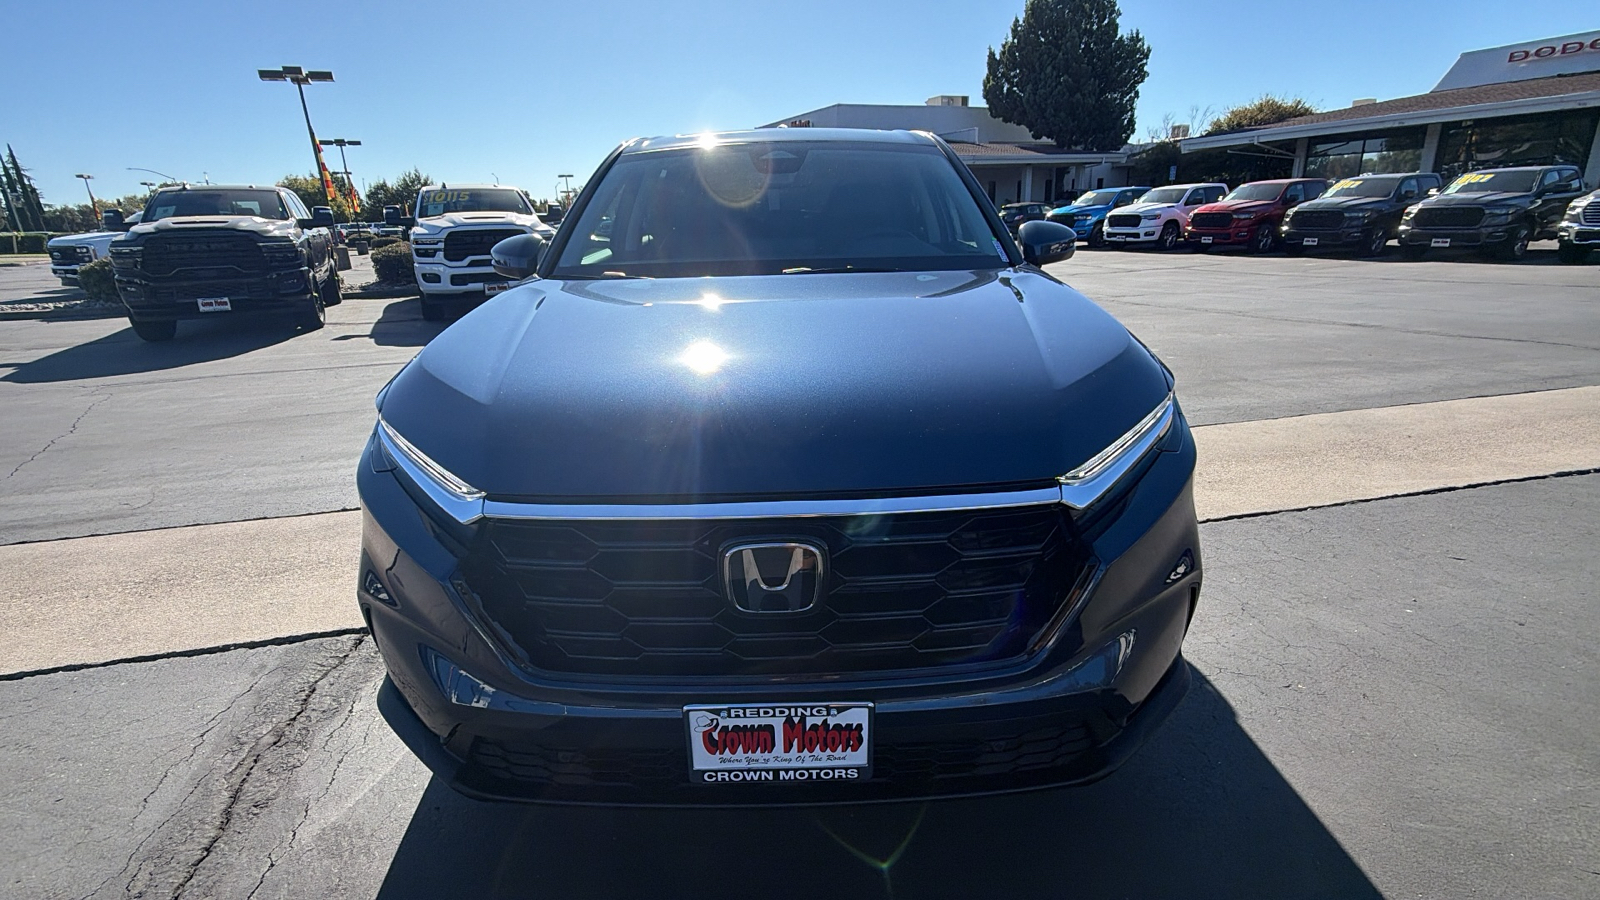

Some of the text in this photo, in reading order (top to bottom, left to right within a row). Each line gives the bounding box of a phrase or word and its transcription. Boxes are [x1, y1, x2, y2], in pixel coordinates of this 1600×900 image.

[730, 707, 828, 718] REDDING
[702, 716, 864, 755] Crown Motors
[718, 754, 848, 766] Where You're King Of The Road
[703, 768, 860, 782] CROWN MOTORS
